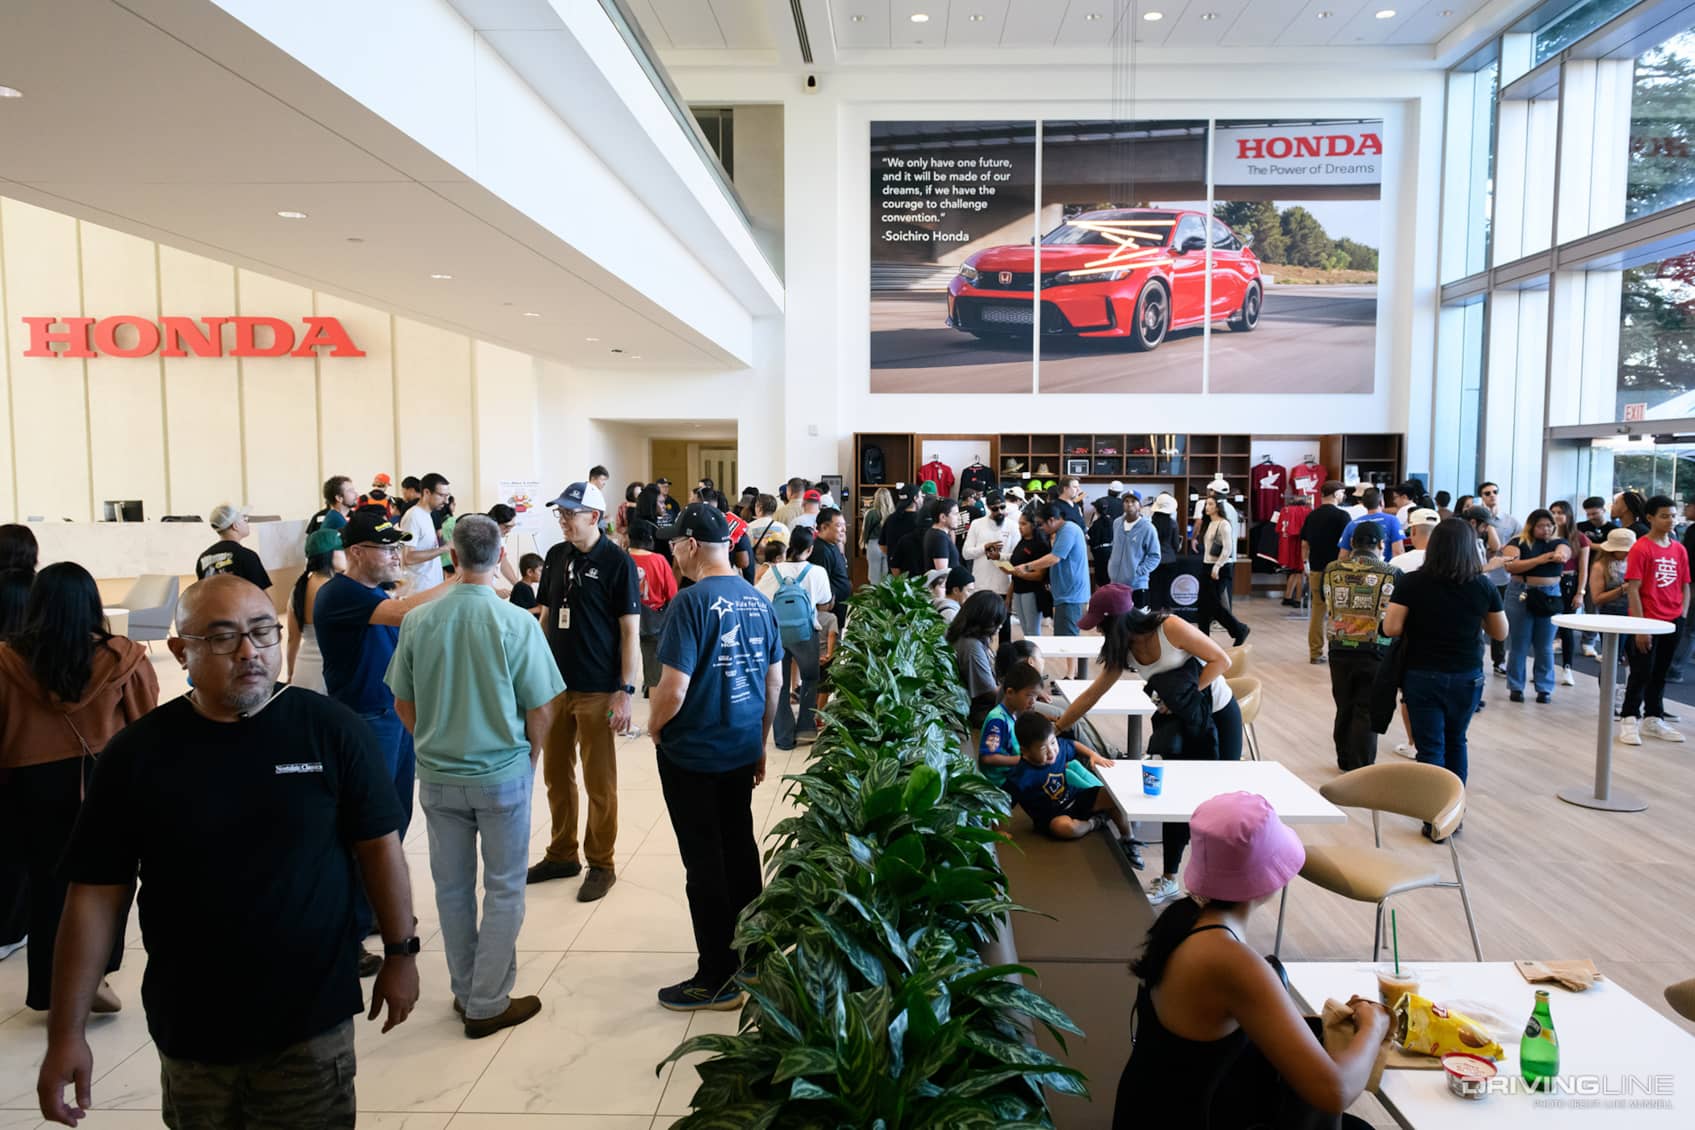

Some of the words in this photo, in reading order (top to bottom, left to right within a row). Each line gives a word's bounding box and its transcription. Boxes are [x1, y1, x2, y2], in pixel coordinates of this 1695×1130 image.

[1236, 133, 1383, 159] HONDA
[907, 158, 928, 170] only
[931, 158, 954, 168] have
[957, 159, 976, 167] one
[979, 157, 1012, 168] future,
[1247, 165, 1268, 175] The
[1270, 165, 1306, 175] Power
[1309, 163, 1321, 174] of
[1325, 163, 1375, 174] Dreams
[882, 171, 901, 180] and
[904, 172, 911, 180] it
[914, 172, 930, 180] will
[934, 172, 946, 180] be
[950, 172, 977, 180] made
[980, 171, 991, 180] of
[882, 185, 922, 196] dreams,
[926, 185, 932, 194] if
[952, 185, 976, 195] have
[979, 185, 995, 194] the
[882, 200, 923, 211] courage
[926, 200, 937, 208] to
[940, 199, 988, 211] challenge
[882, 231, 929, 241] -Soichiro
[933, 231, 969, 241] Honda
[22, 315, 367, 359] HONDA
[1626, 404, 1645, 421] EXIT
